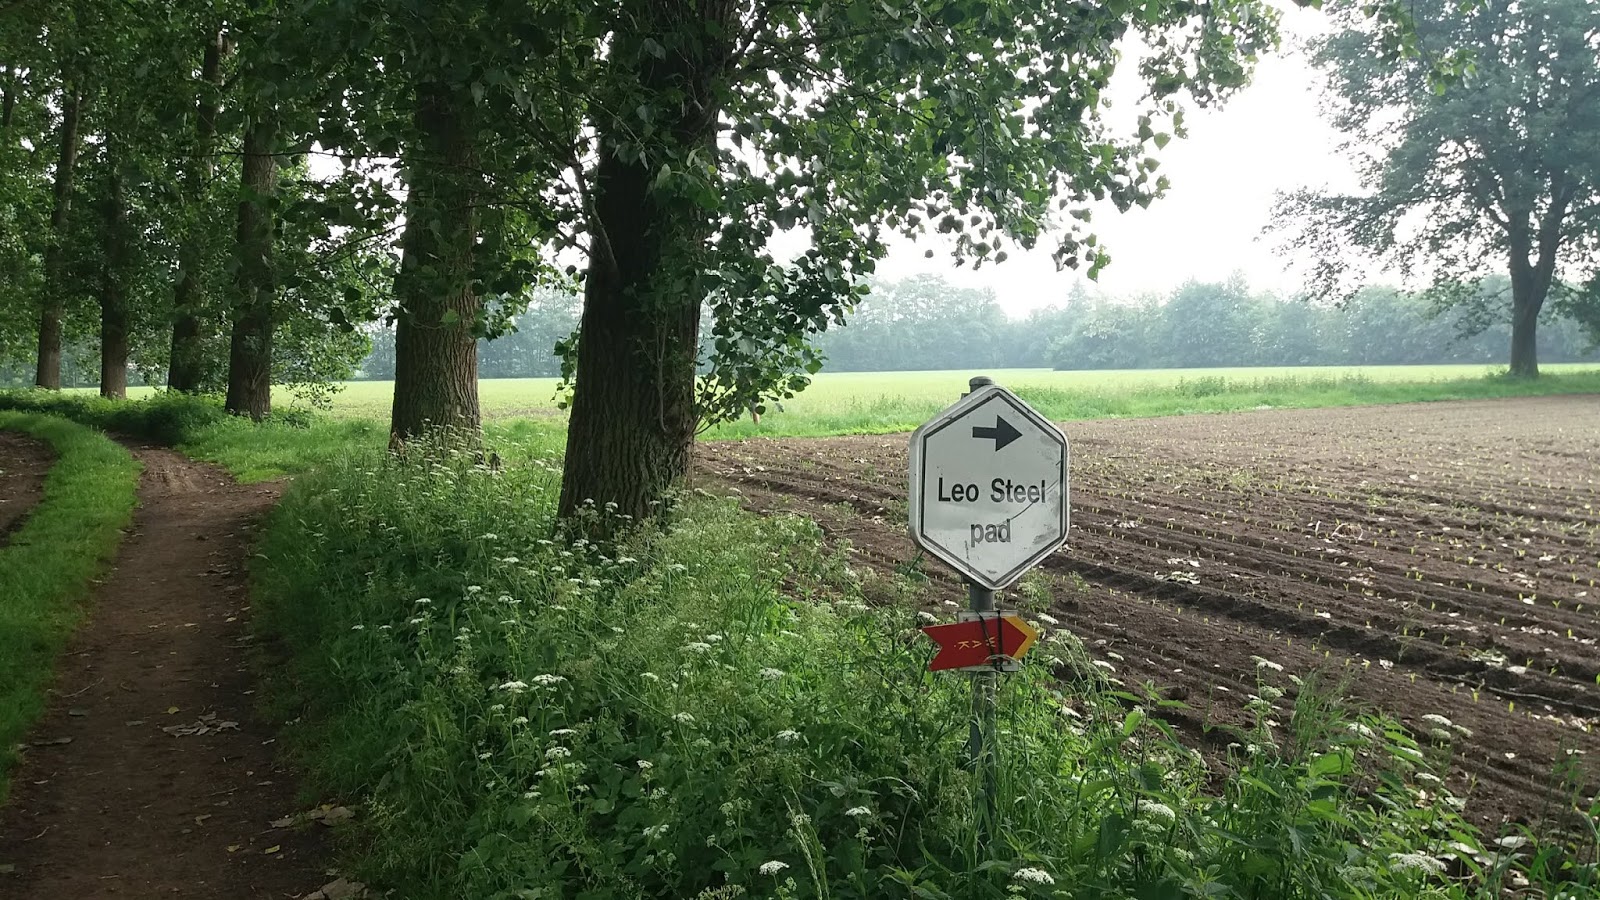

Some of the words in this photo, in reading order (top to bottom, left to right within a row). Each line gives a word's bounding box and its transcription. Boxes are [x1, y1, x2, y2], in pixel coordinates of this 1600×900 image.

[938, 477, 979, 502] Leo
[990, 477, 1046, 503] Steel
[970, 518, 1011, 548] pad
